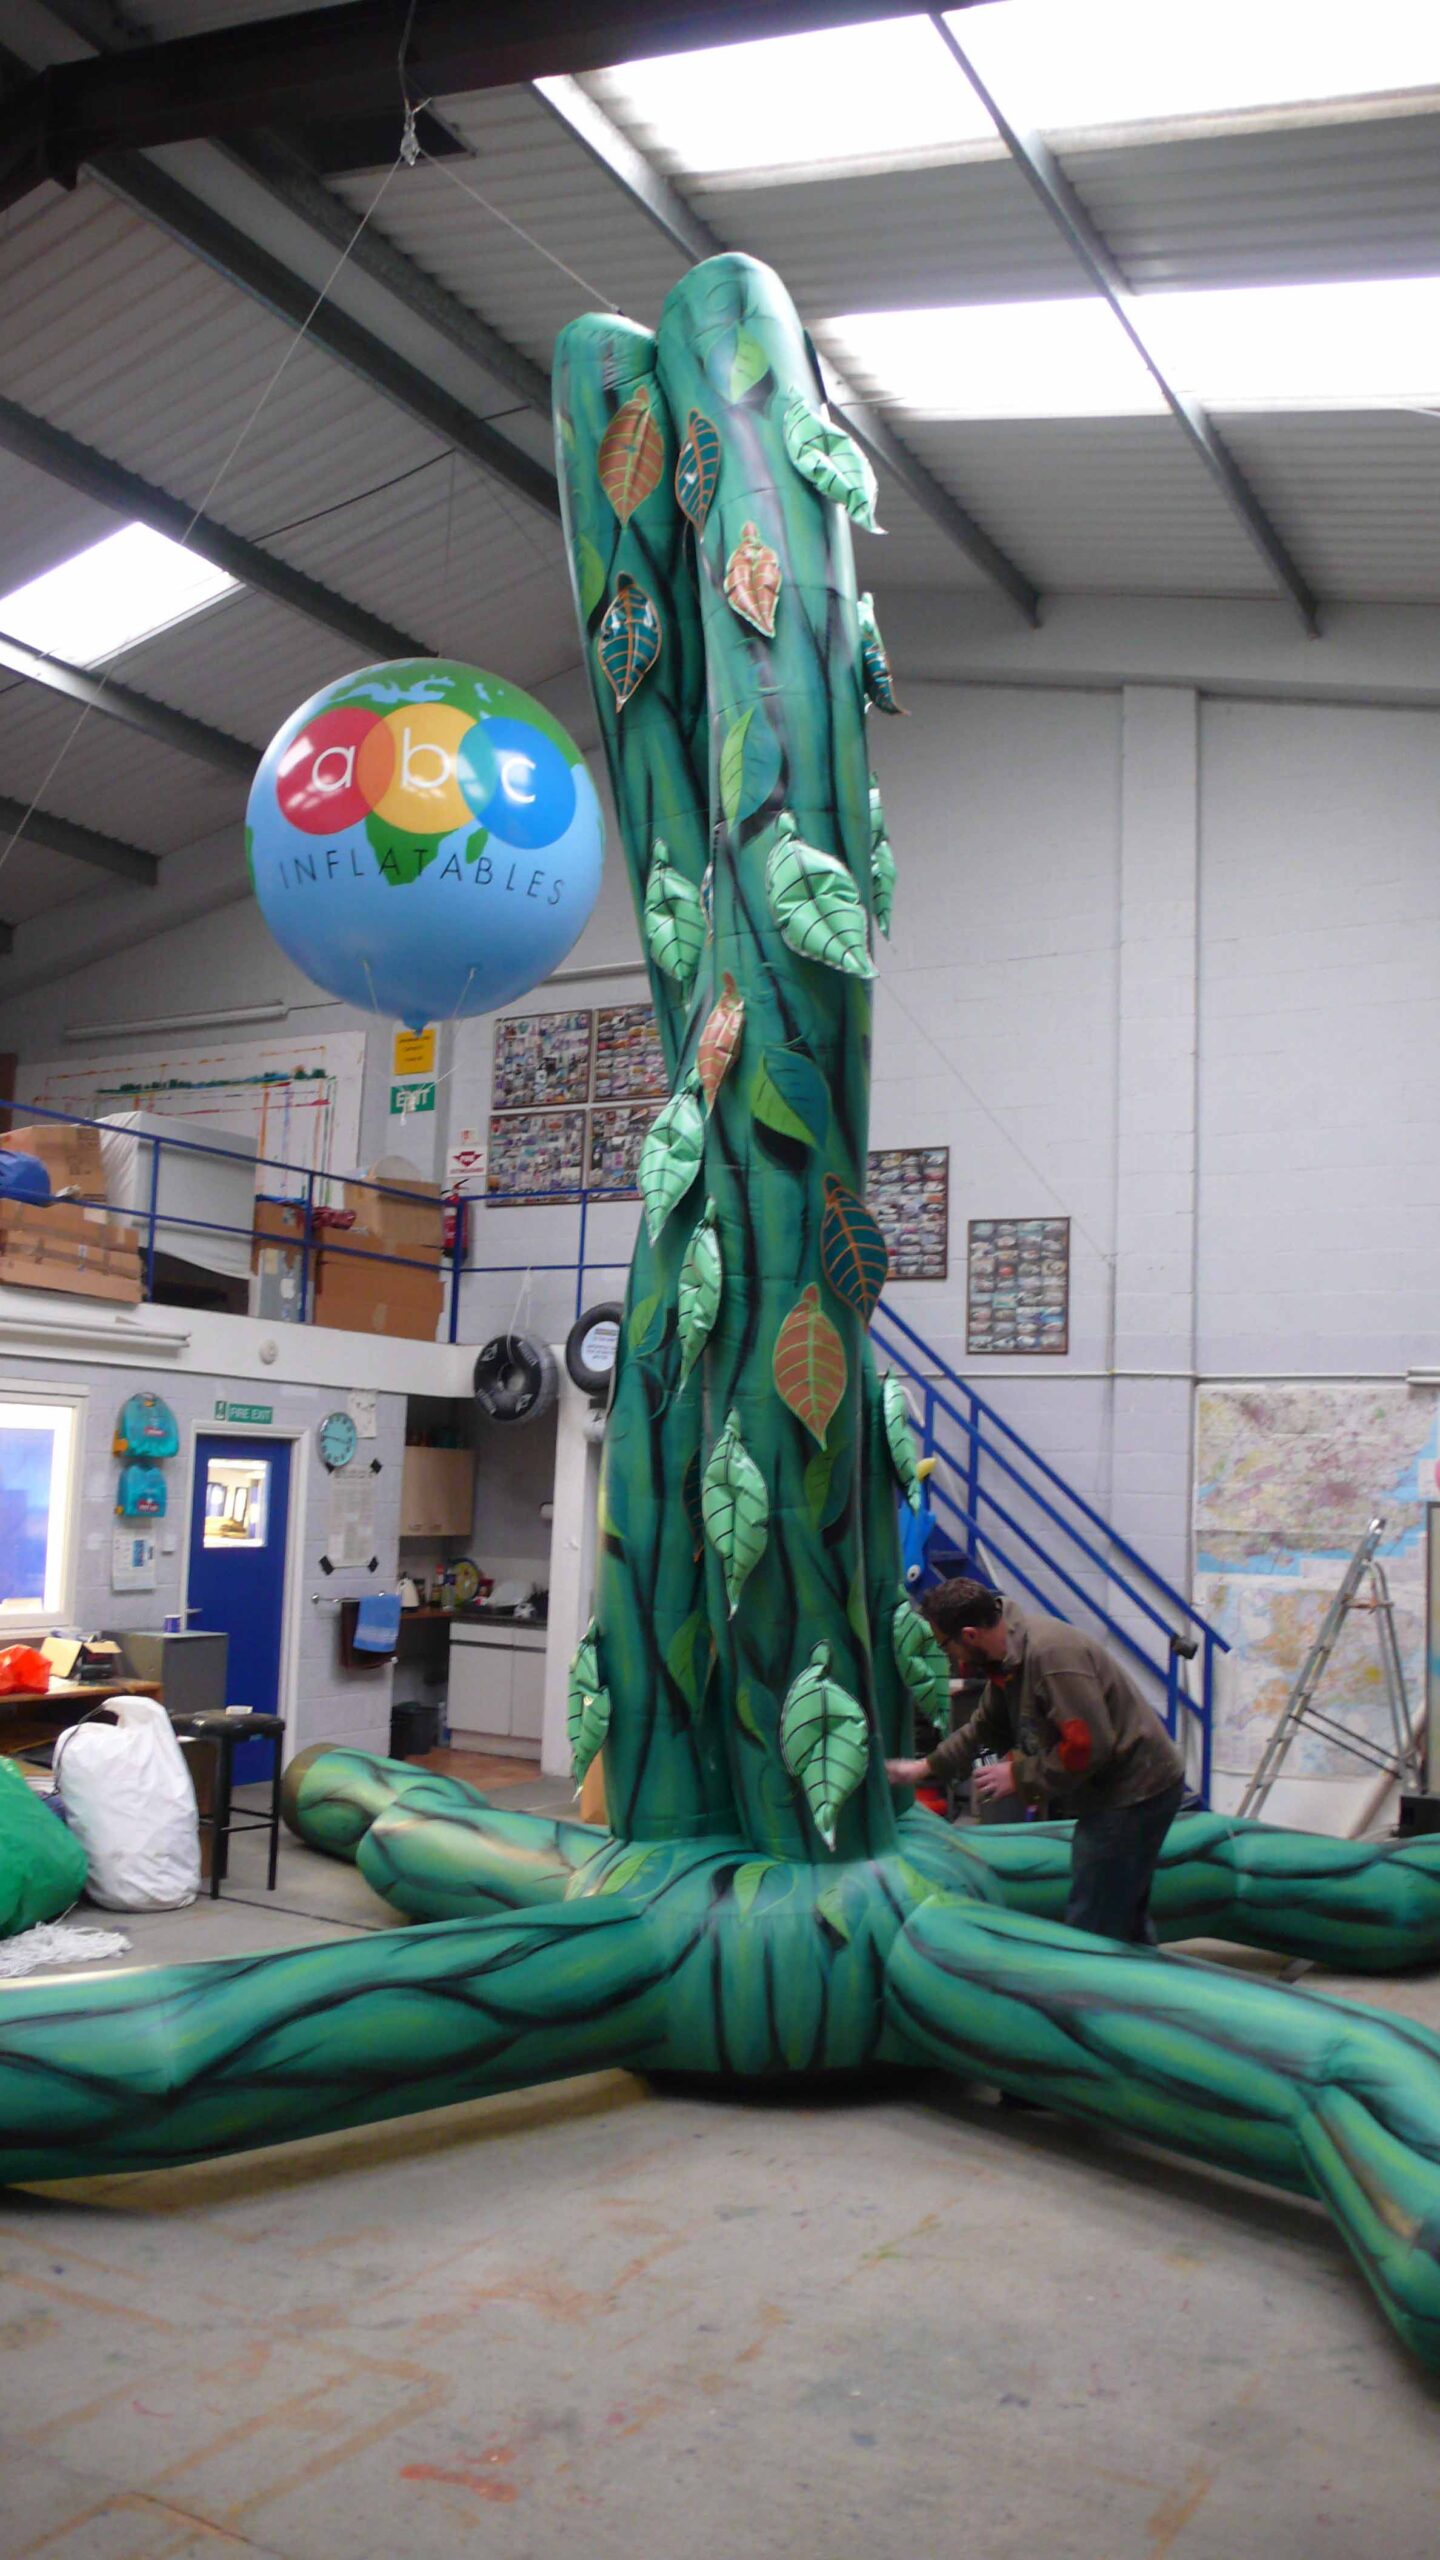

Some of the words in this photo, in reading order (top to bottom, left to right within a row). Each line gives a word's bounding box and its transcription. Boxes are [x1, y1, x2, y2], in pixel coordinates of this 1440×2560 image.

[279, 848, 565, 905] INFLATABLES
[229, 1407, 250, 1419] FIRE
[251, 1409, 272, 1421] EXIT
